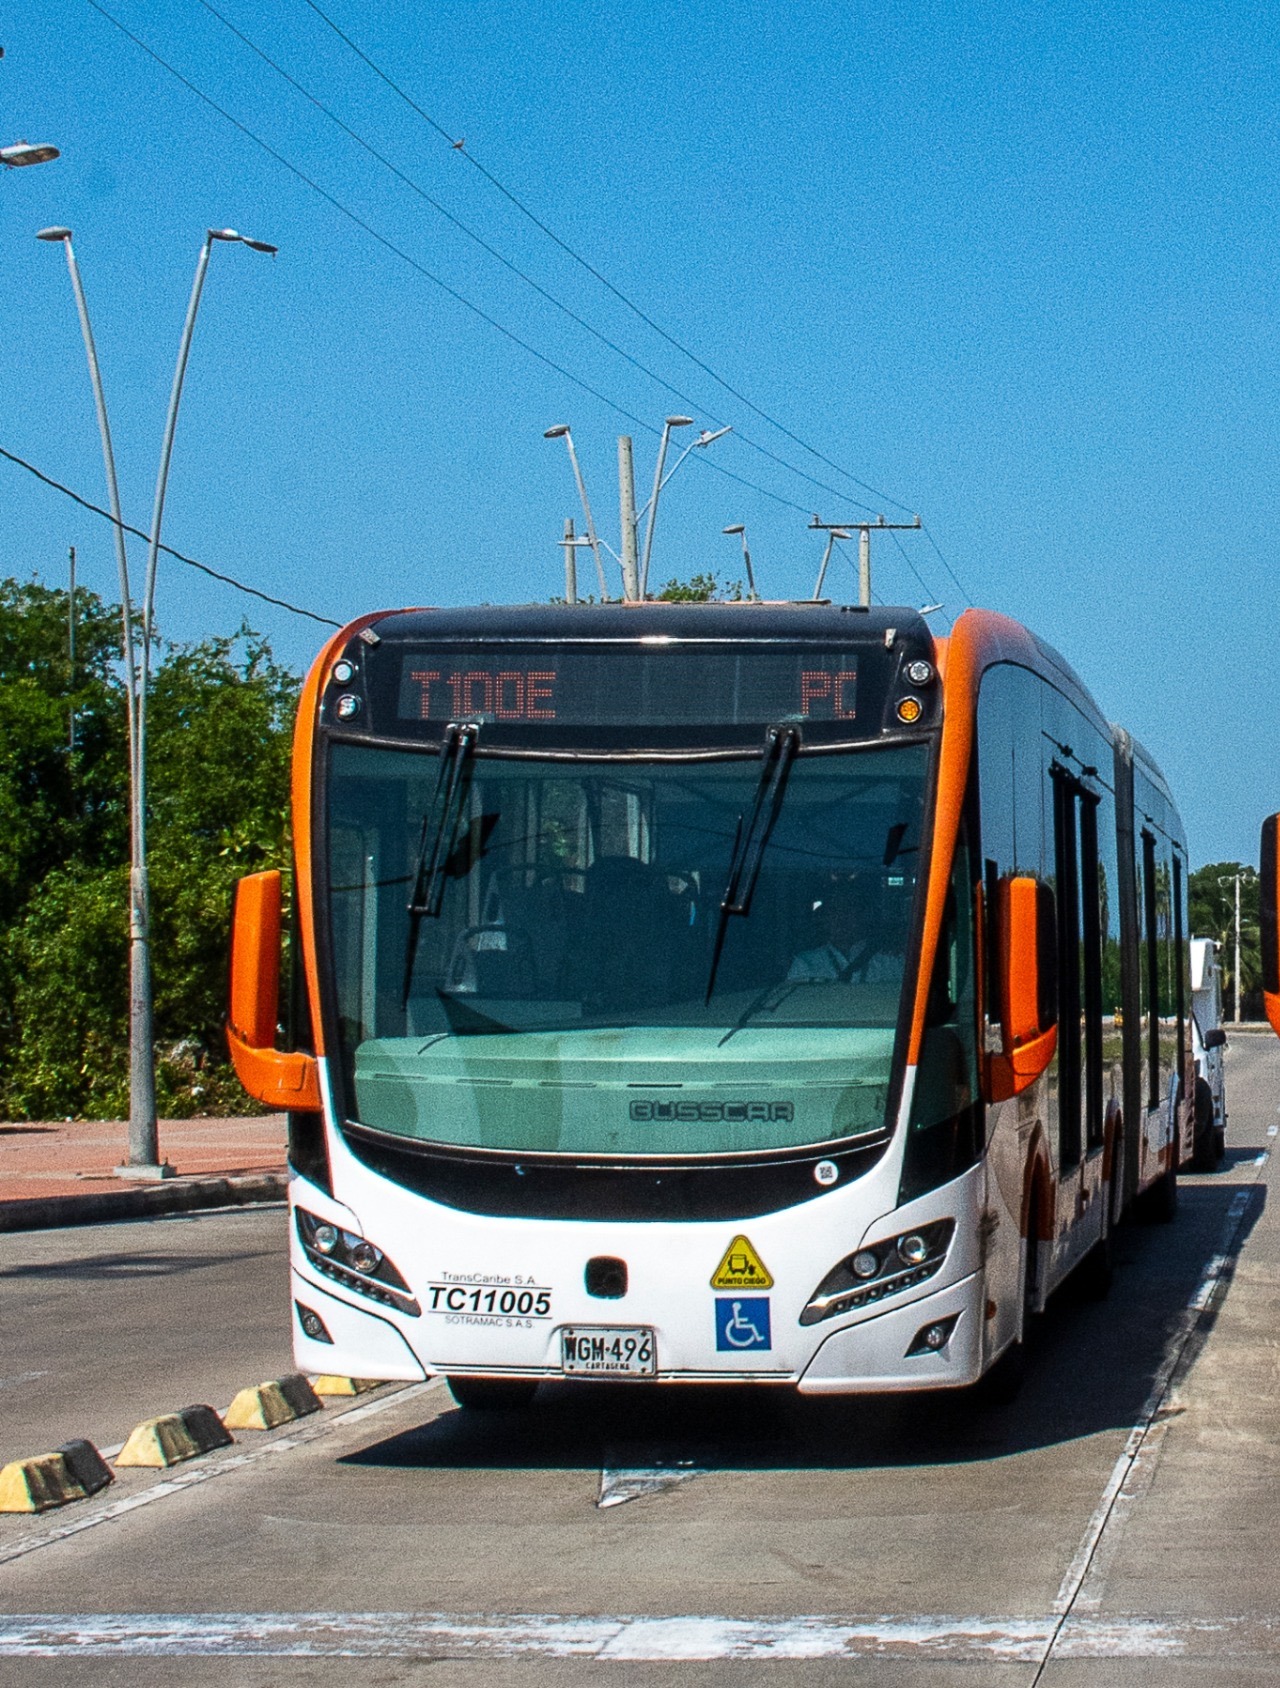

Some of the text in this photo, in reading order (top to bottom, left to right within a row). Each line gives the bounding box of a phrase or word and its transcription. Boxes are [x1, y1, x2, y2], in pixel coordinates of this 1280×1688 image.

[629, 1100, 795, 1123] BUSSCAR
[441, 1271, 512, 1285] TransCaribe
[429, 1286, 551, 1316] TC11005
[445, 1315, 504, 1328] SOTRAMAC
